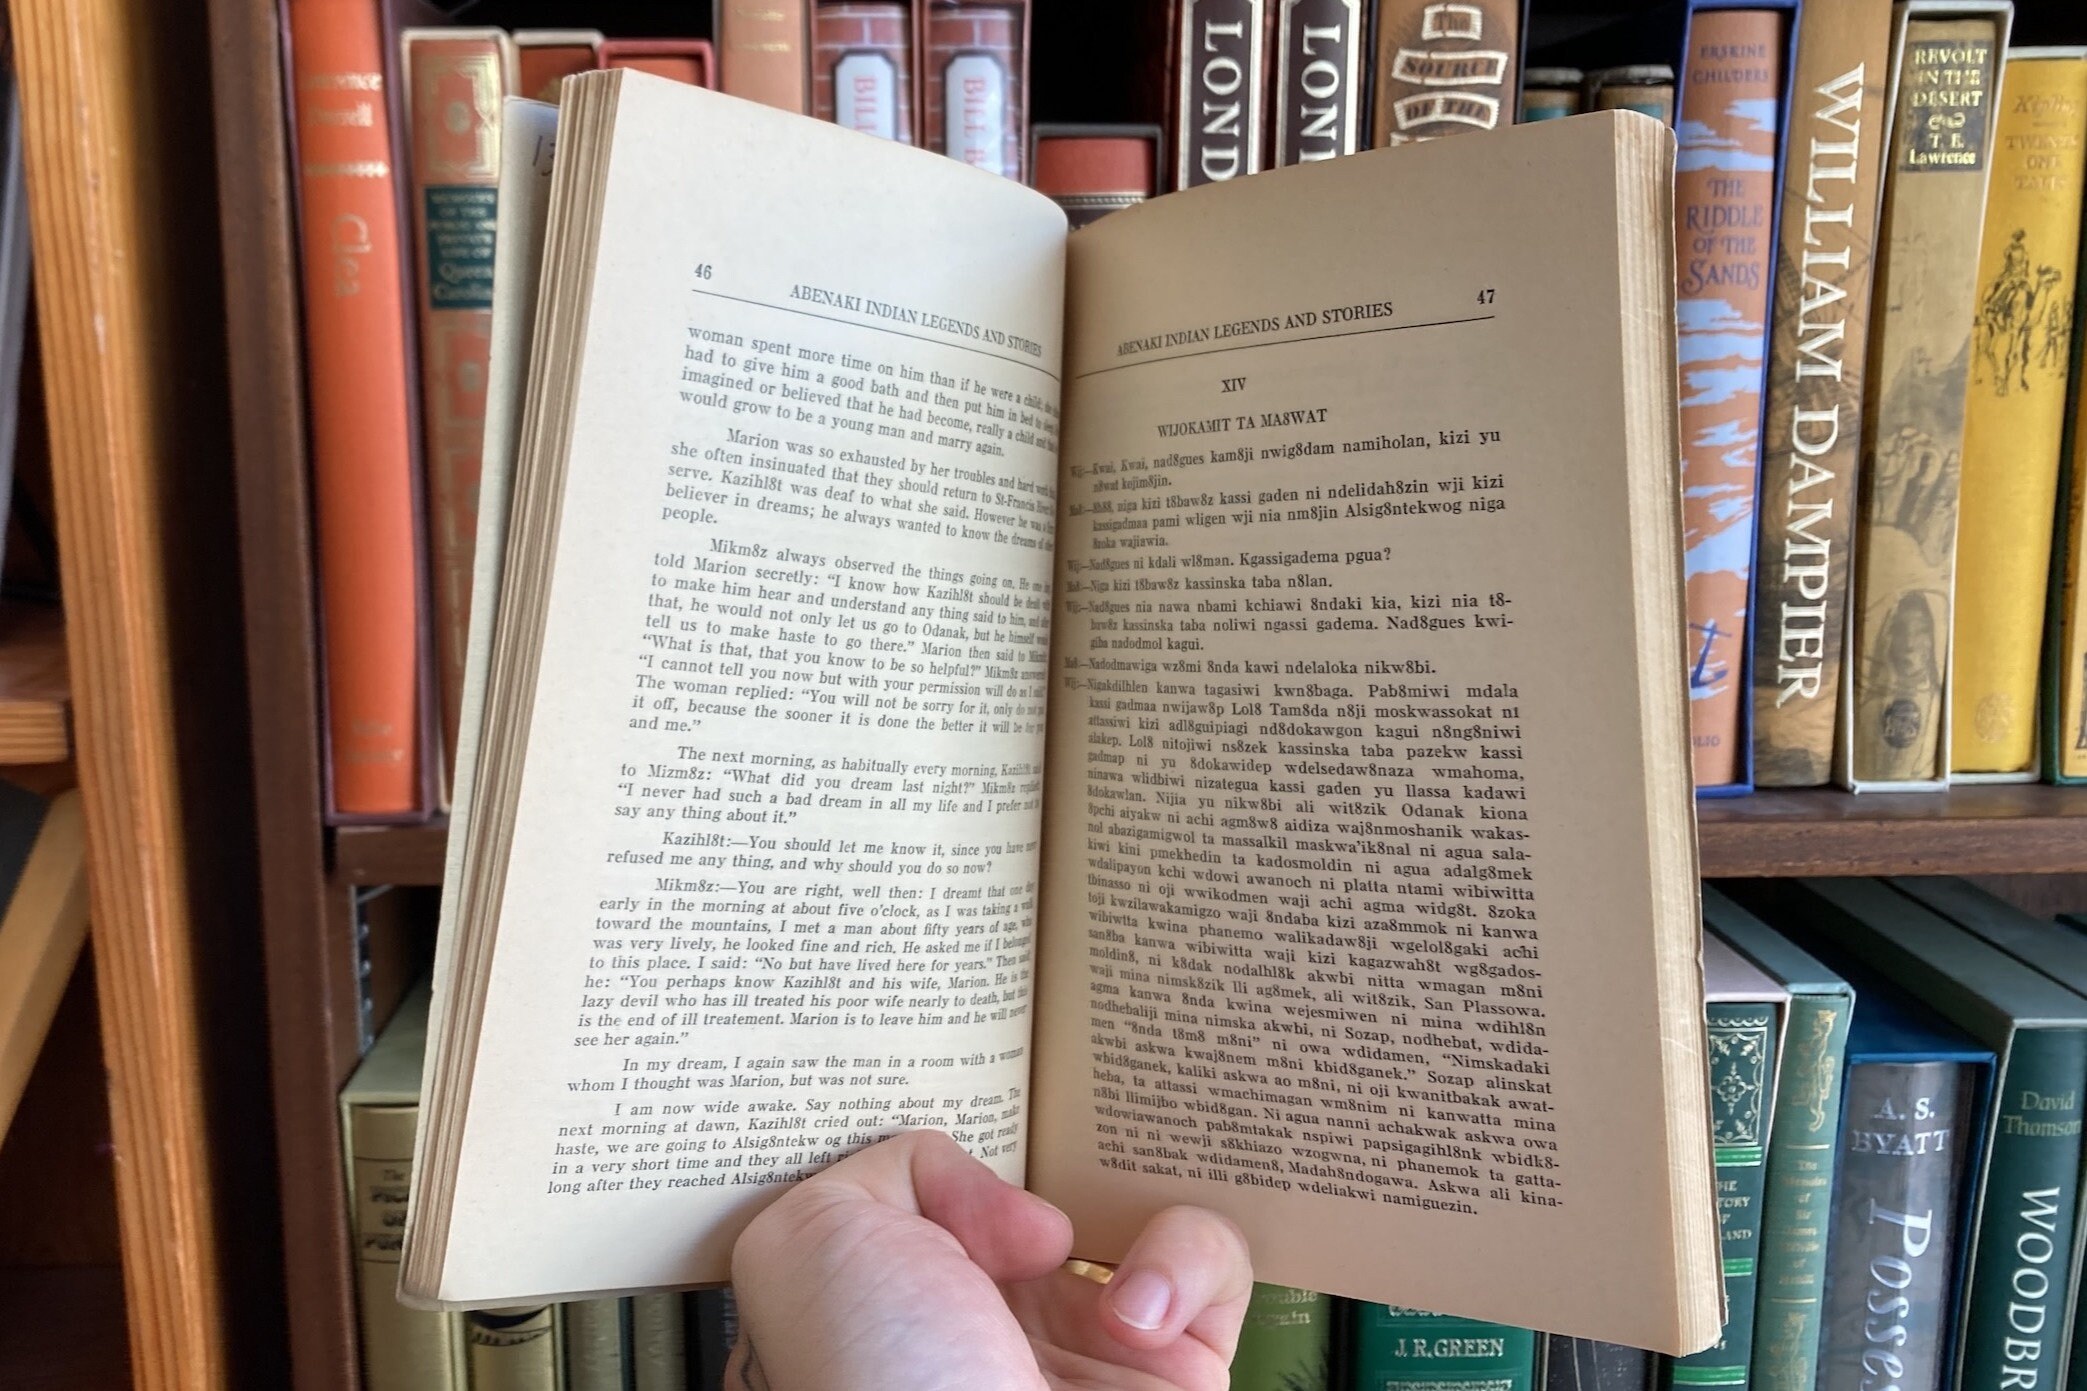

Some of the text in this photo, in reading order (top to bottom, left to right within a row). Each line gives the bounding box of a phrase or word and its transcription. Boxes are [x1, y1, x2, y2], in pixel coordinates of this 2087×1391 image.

[1700, 44, 1766, 60] ERSKINE
[1915, 48, 1987, 65] REVOLT
[1692, 69, 1768, 84] CHILDERS
[1918, 70, 1938, 85] IN
[1201, 20, 1243, 181] LOND
[1912, 90, 1983, 107] DESERT
[1909, 148, 1976, 165] Lawrence
[1707, 178, 1744, 198] THE
[1687, 205, 1763, 234] RIDDLE
[1693, 236, 1756, 254] OF THE
[694, 263, 713, 280] 46
[1682, 259, 1761, 294] SANDS
[1476, 289, 1496, 305] 47
[788, 283, 1041, 358] ABENAKI INDIAN LEGENDS AND STORIES
[1164, 326, 1210, 347] INDIAN
[1213, 316, 1280, 339] LEGENDS
[1283, 310, 1317, 330] AND
[1321, 300, 1393, 324] STORIES
[686, 326, 1014, 402] woman spent more time on him than if he were
[1220, 376, 1248, 394] XIV
[1776, 62, 1864, 709] WILLIAM DAMPIER
[678, 390, 728, 409] would
[731, 399, 772, 415] grow
[775, 404, 791, 419] to
[794, 406, 813, 423] be
[816, 413, 826, 426] a
[829, 415, 874, 436] young
[876, 424, 905, 439] man
[909, 429, 934, 444] and
[936, 434, 973, 453] marry
[1156, 407, 1328, 438] WIJOKAMIT TA MA8WAT
[1209, 428, 1501, 463] kam8ji nwig8dam namiholan, kizi yu
[660, 506, 718, 524] people.
[1132, 545, 1391, 569] ni kdali wl8man. Kgassigadema pgua?
[653, 552, 685, 569] told
[692, 555, 747, 576] Marion
[754, 567, 819, 586] secretly:
[847, 575, 887, 592] know
[891, 580, 921, 596] how
[925, 584, 973, 603] Kazihl8t
[977, 590, 1010, 607] should
[1112, 572, 1333, 592] kizi t8baw8z kassinska taba n8lan.
[1160, 658, 1437, 674] wz8mi 8nda kawi ndelaloka nikw8bi.
[627, 715, 659, 730] and
[605, 849, 664, 865] refused
[668, 854, 693, 866] me
[697, 855, 728, 869] any
[731, 853, 774, 871] thing,
[778, 856, 808, 870] and
[812, 856, 844, 874] why
[846, 858, 893, 874] should
[896, 863, 922, 876] you
[925, 860, 942, 874] do
[945, 864, 960, 875] so
[572, 1035, 599, 1047] see
[602, 1031, 630, 1046] her
[1090, 1032, 1127, 1050] akwbi
[1134, 1039, 1176, 1057] askwa
[1264, 1055, 1304, 1071] m8ni
[1426, 1069, 1475, 1089] Sozap
[1484, 1074, 1553, 1094] alinskat
[566, 1077, 615, 1092] whom
[619, 1076, 629, 1091] I
[633, 1074, 691, 1092] thought
[695, 1077, 725, 1088] was
[728, 1073, 784, 1089] Marion,
[787, 1072, 813, 1087] but
[817, 1075, 845, 1086] was
[848, 1073, 872, 1086] not
[1873, 1097, 1936, 1121] A. S.
[2020, 1089, 2076, 1111] David
[2002, 1115, 2083, 1137] Thomson
[1851, 1128, 1950, 1156] BYATT
[546, 1180, 582, 1195] long
[585, 1177, 624, 1192] after
[628, 1175, 663, 1191] they
[666, 1172, 726, 1188] reached
[1098, 1156, 1137, 1172] w8dit
[1141, 1161, 1183, 1179] sakat,
[1186, 1166, 1202, 1179] ni
[1207, 1168, 1229, 1182] illi
[1295, 1180, 1376, 1202] wdeliakwi
[1717, 1180, 1738, 1192] HE
[2000, 1187, 2061, 1390] WOODBR
